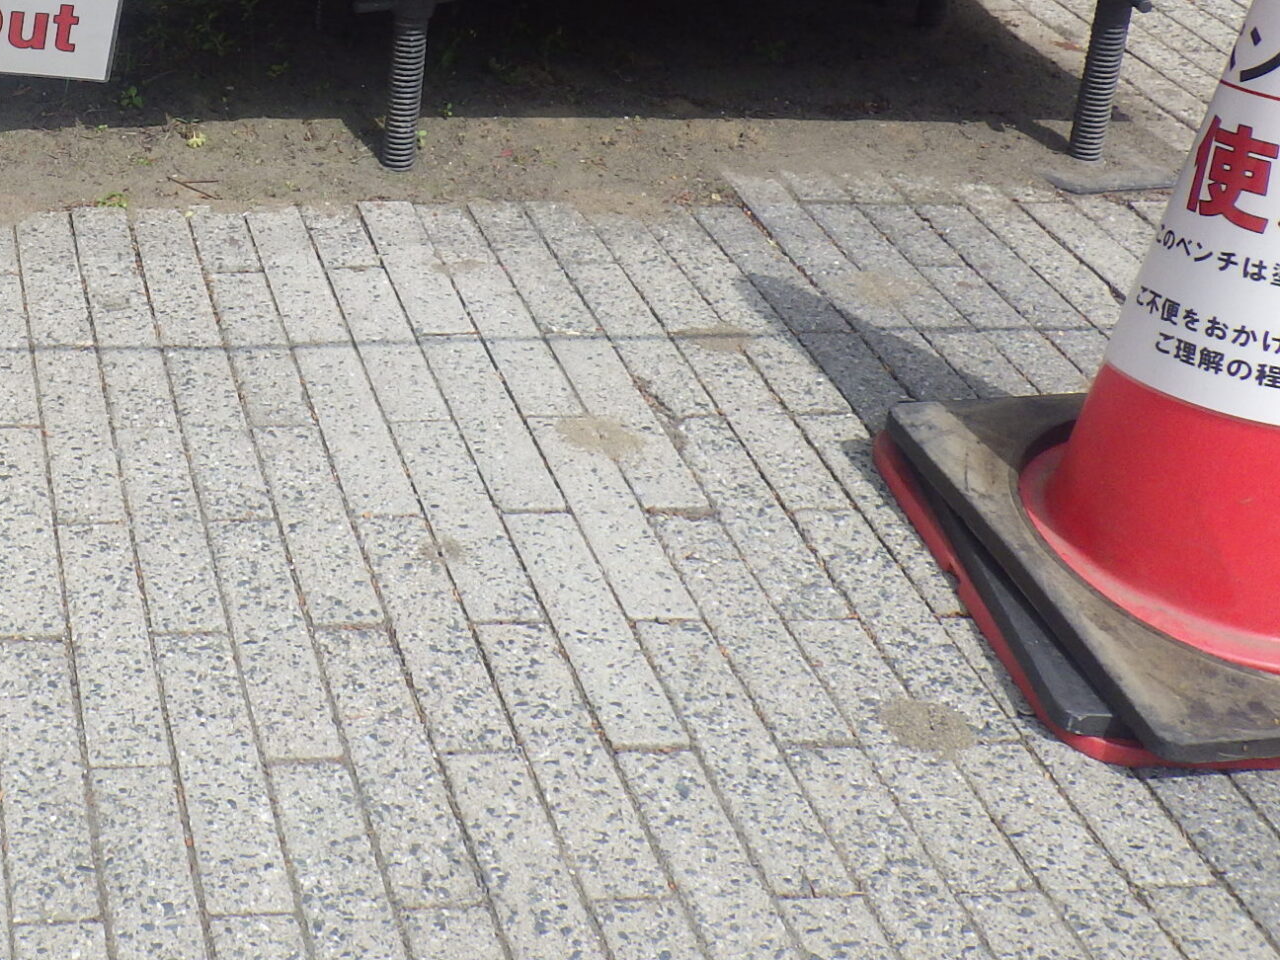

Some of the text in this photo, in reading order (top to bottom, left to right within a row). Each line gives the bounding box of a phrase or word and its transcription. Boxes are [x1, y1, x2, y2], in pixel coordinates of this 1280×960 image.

[1155, 332, 1280, 389] ご理解の程
